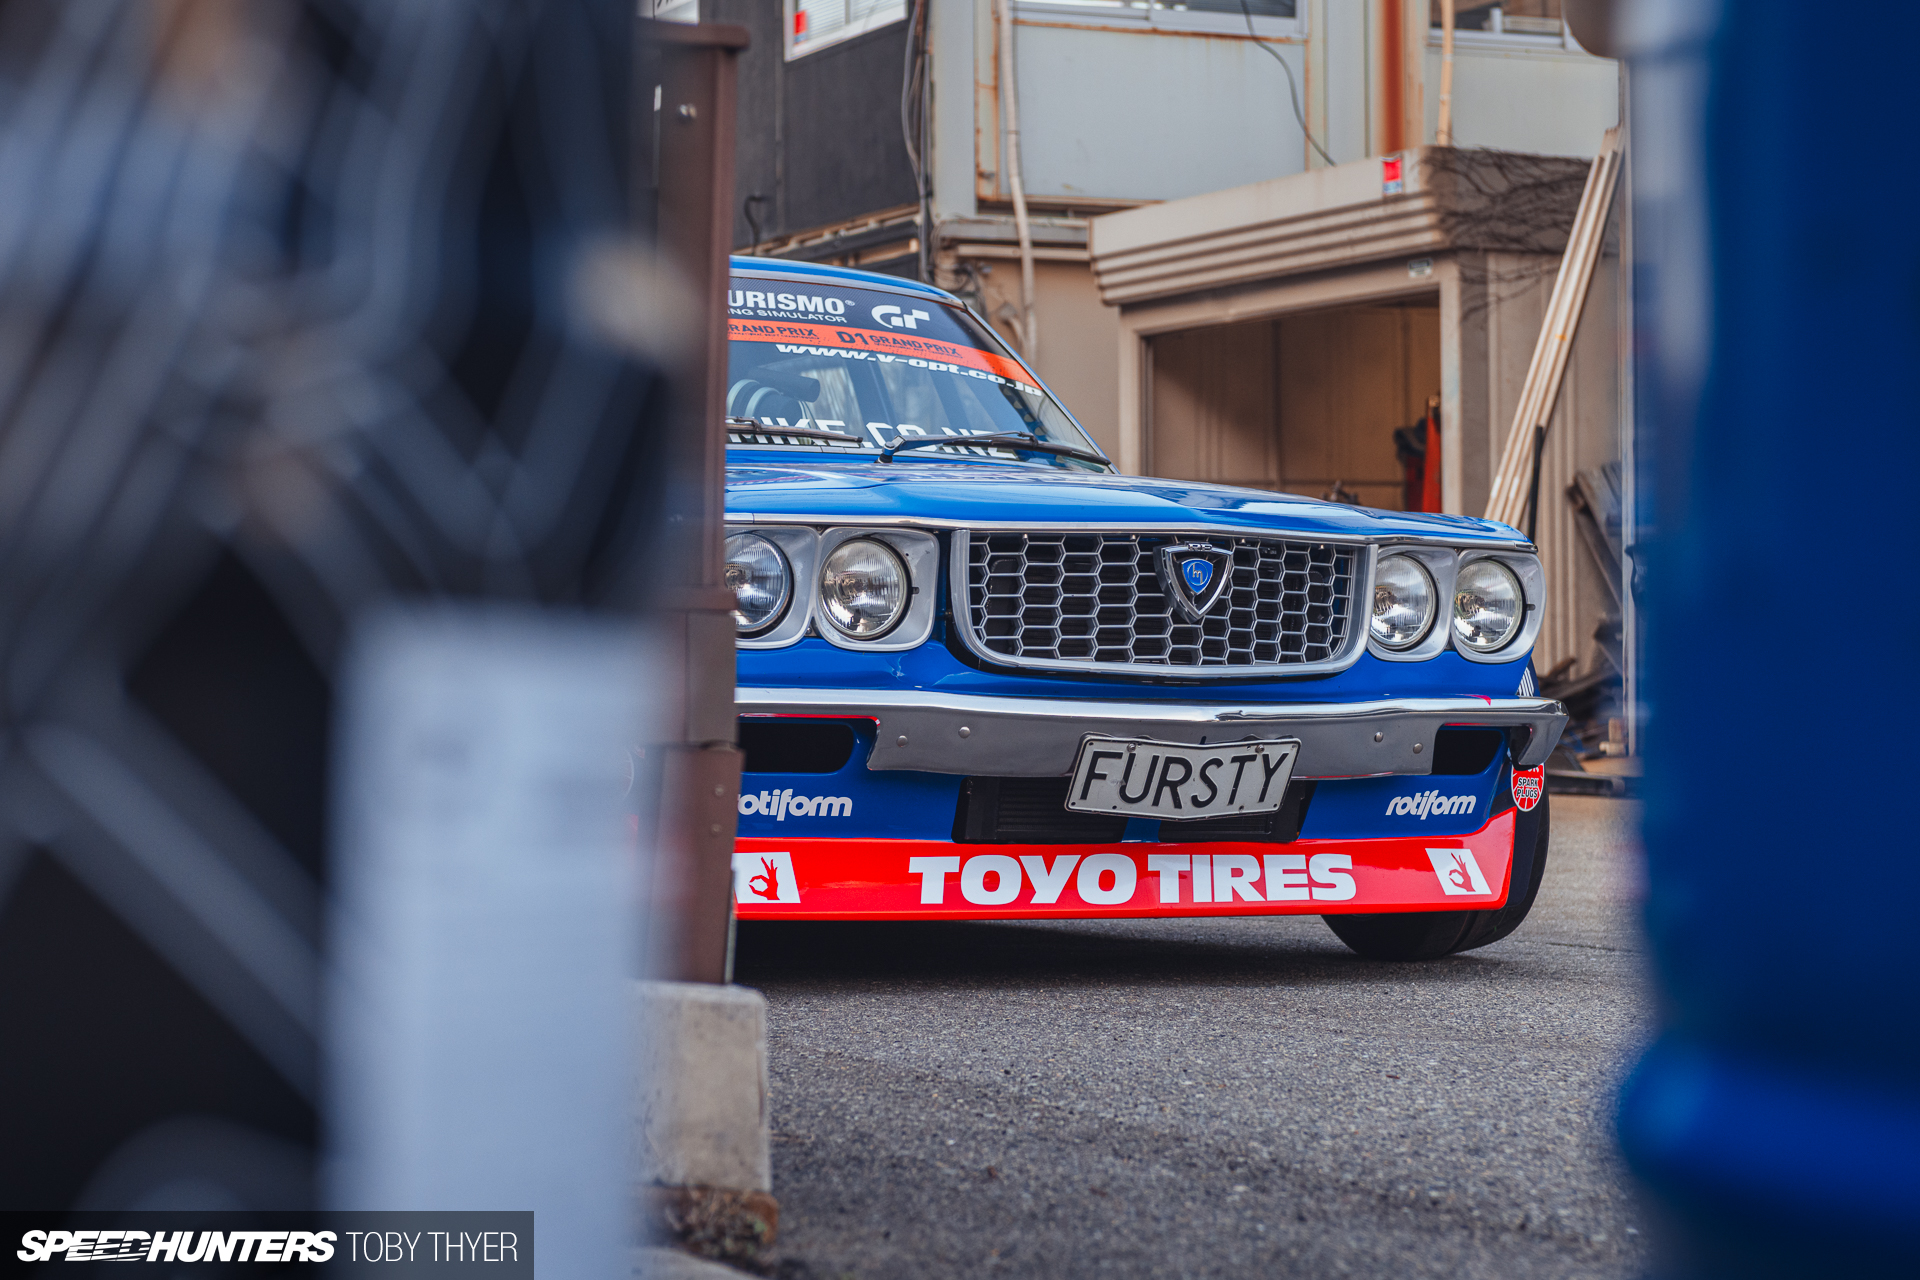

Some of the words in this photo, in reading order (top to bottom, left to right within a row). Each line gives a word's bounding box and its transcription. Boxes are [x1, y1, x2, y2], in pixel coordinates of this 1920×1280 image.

[757, 309, 847, 323] SIMULATOR
[776, 326, 817, 338] PRIX
[836, 331, 869, 346] D1
[869, 335, 923, 349] GRAND
[923, 342, 962, 357] PRIX
[775, 344, 1042, 397] www.v-opt.co.jp
[1079, 750, 1289, 811] FURSTY
[1516, 788, 1538, 799] PLUGS
[1517, 777, 1539, 788] SPARK
[737, 788, 852, 821] otiform
[1385, 790, 1476, 820] rotiform
[908, 854, 1137, 905] TOYO
[1148, 853, 1357, 904] TIRES
